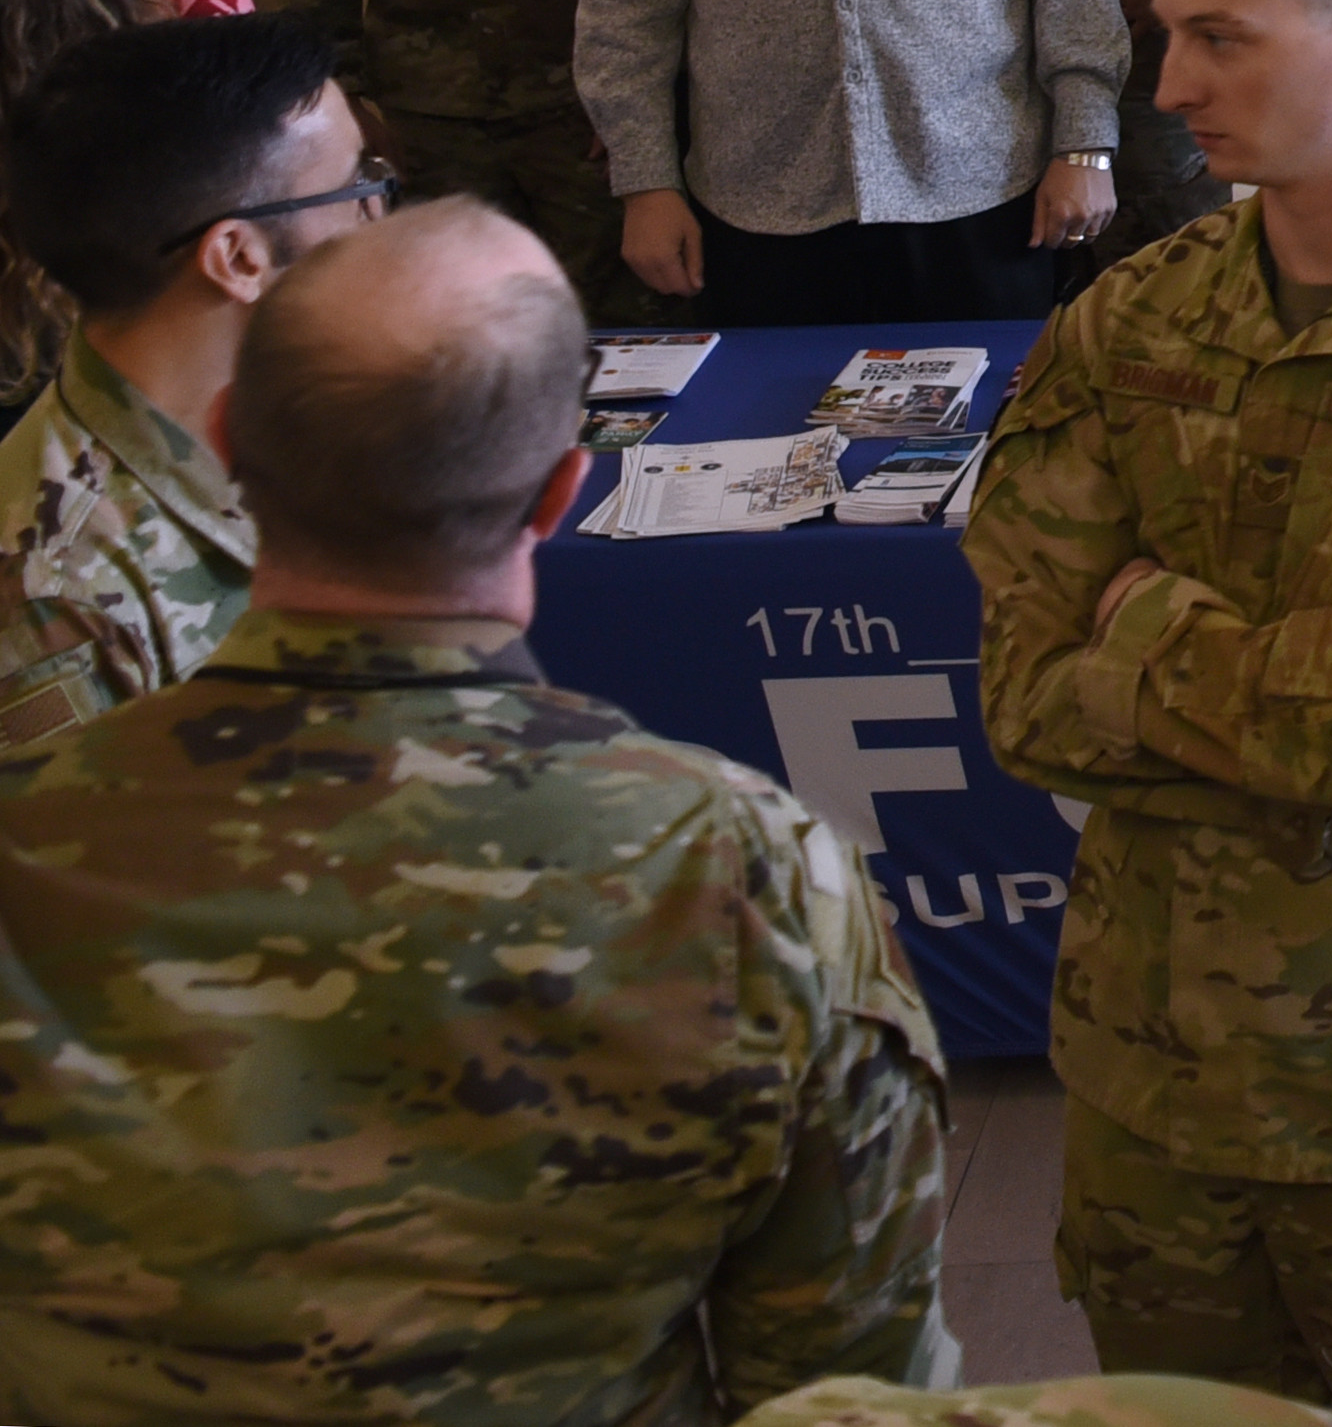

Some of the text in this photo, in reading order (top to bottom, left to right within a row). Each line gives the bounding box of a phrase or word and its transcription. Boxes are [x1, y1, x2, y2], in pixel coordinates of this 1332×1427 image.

[866, 360, 957, 369] COLLEGE
[859, 373, 901, 381] TIPS
[745, 603, 900, 658] 17th
